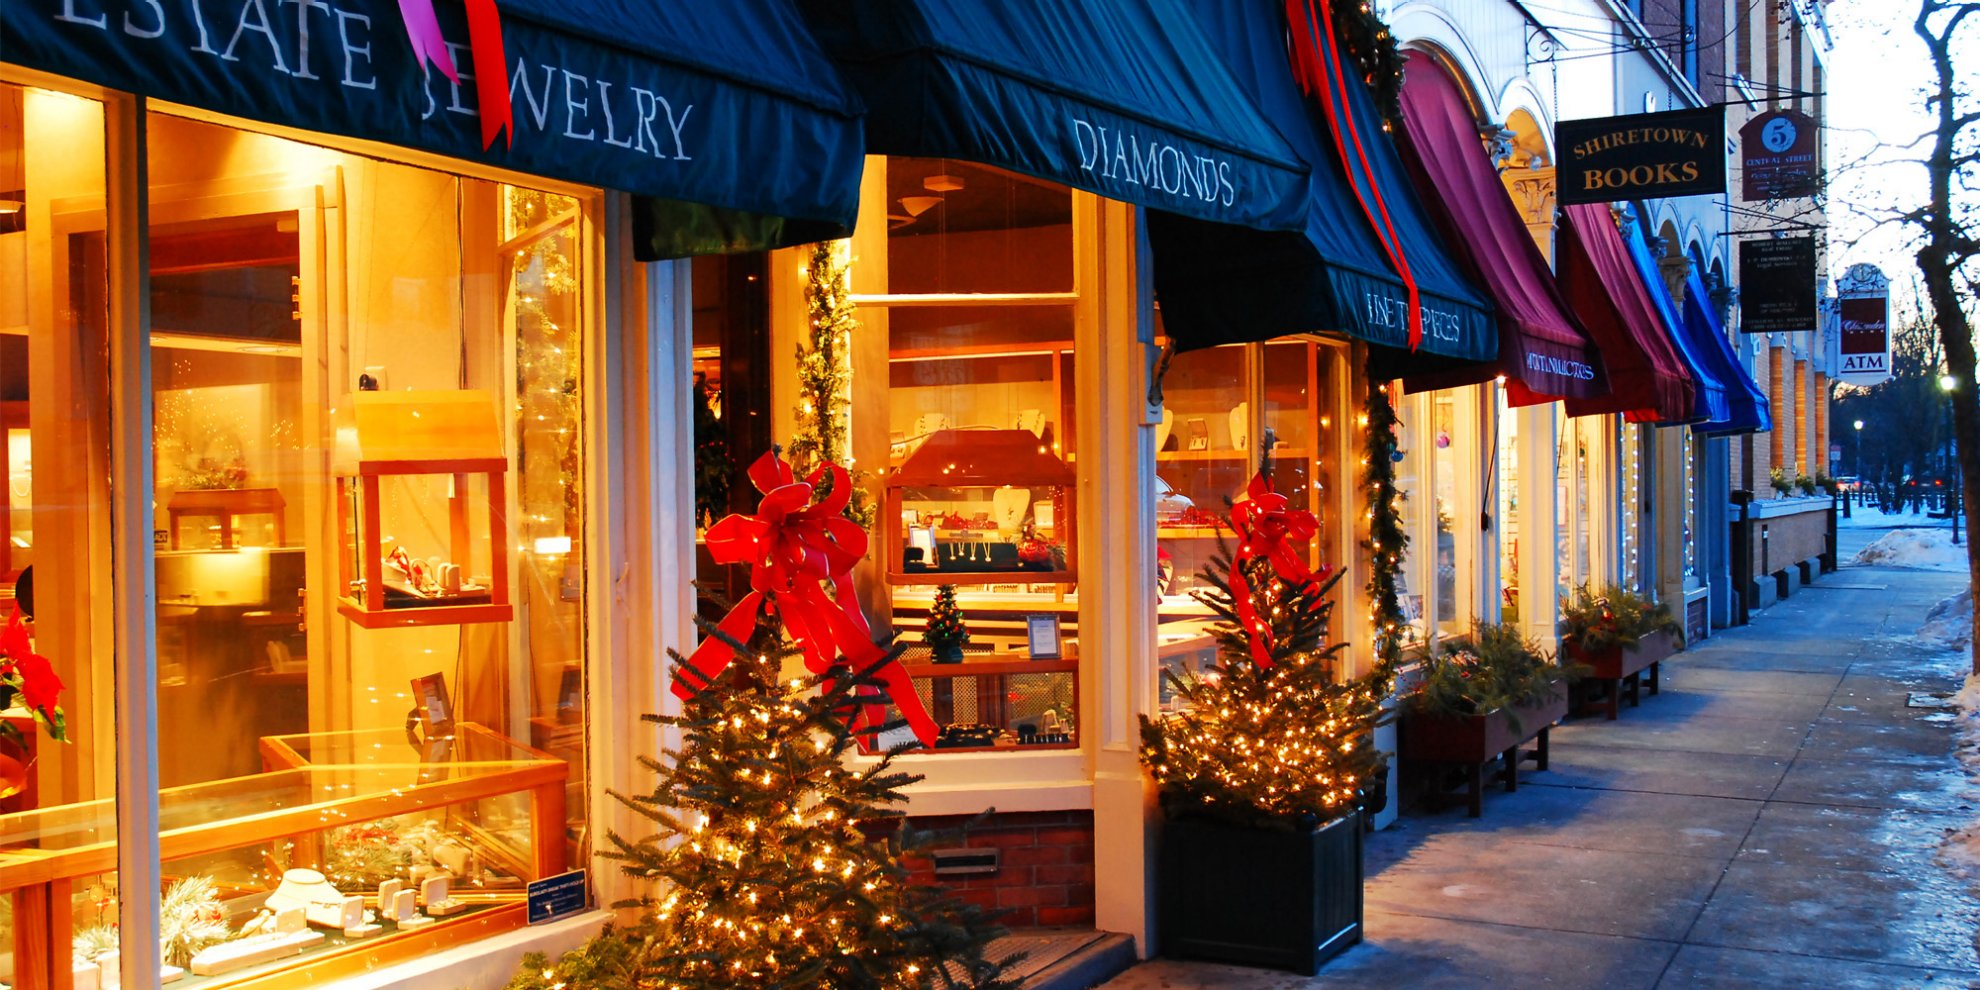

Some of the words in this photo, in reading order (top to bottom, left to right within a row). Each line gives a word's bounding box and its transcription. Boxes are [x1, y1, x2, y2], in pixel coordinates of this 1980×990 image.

[1573, 127, 1709, 160] SHIRETOWN
[1771, 125, 1787, 145] 5
[1073, 119, 1234, 207] DIAMONDS
[1583, 161, 1699, 190] BOOKS
[1844, 355, 1883, 369] ATM
